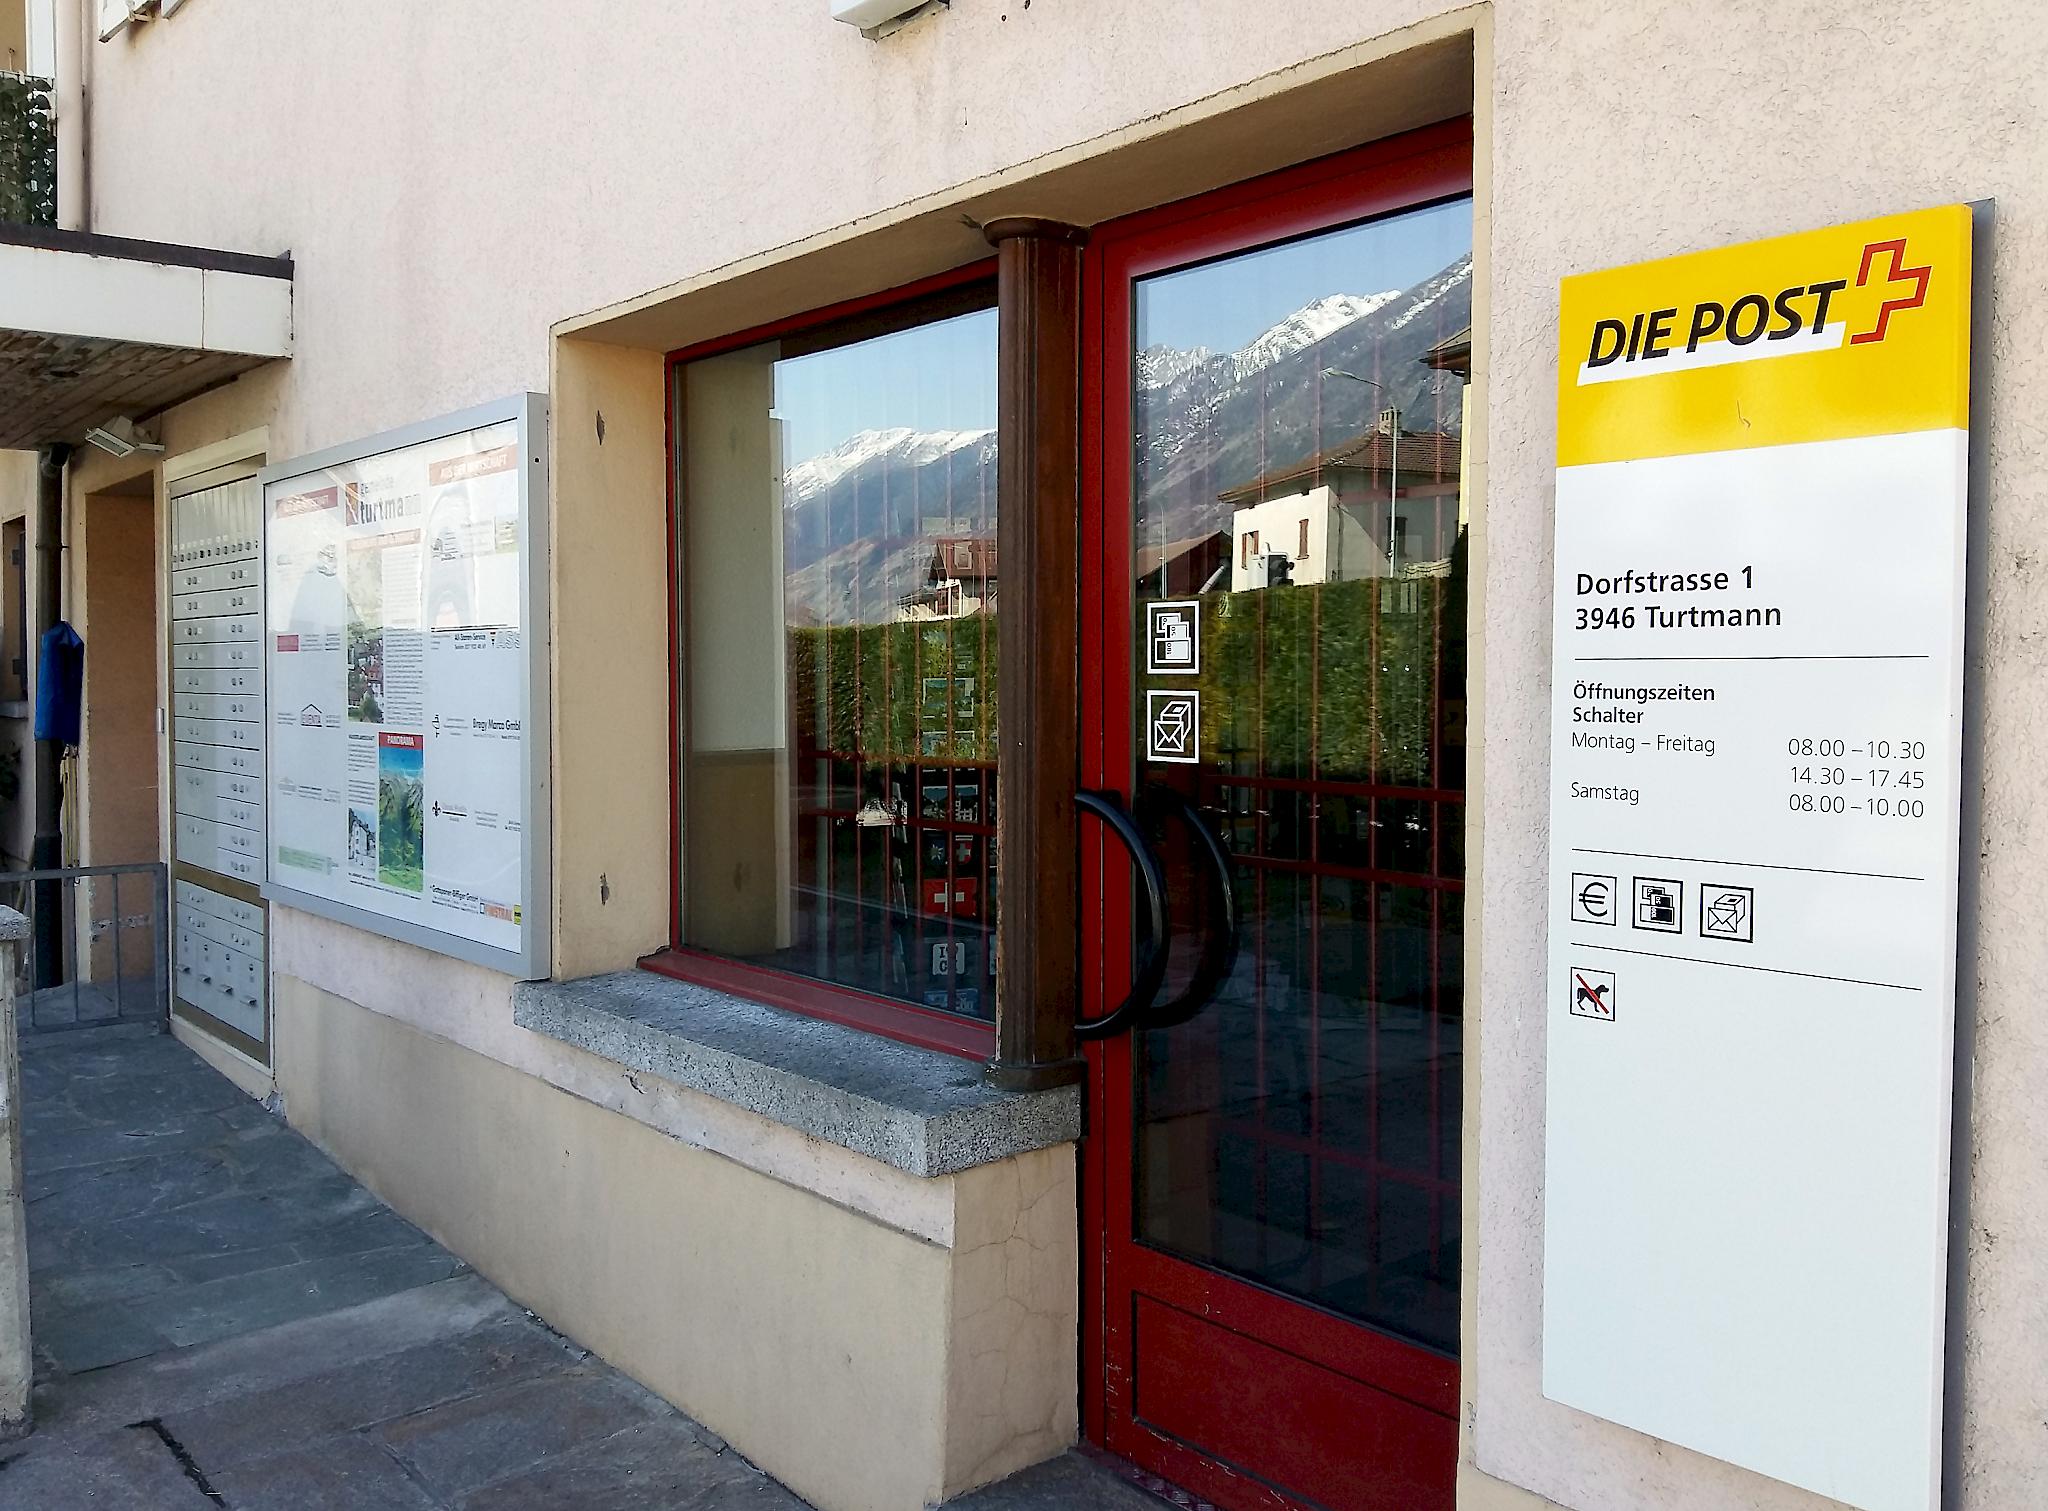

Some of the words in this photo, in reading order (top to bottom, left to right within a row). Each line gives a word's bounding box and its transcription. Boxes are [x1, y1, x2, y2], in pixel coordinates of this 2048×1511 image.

[1587, 308, 1677, 368] DIE
[1686, 279, 1848, 354] POST
[1577, 569, 1729, 595] Dorfstrasse
[1741, 566, 1753, 589] 1
[1575, 606, 1636, 630] 3946
[1645, 605, 1781, 629] Turtmann
[1573, 679, 1717, 704] Öffnungszeiten
[1573, 706, 1645, 724] Schalter
[1571, 732, 1635, 754] Montag
[1657, 734, 1715, 757] Freitag
[1788, 737, 1845, 758] 08.00
[1867, 741, 1925, 760] 10.30
[1790, 766, 1845, 786] 14.30
[1869, 769, 1925, 789] 17.45
[1571, 782, 1640, 805] Samstag
[1789, 794, 1845, 814] 08.00
[1867, 797, 1924, 818] 10.00
